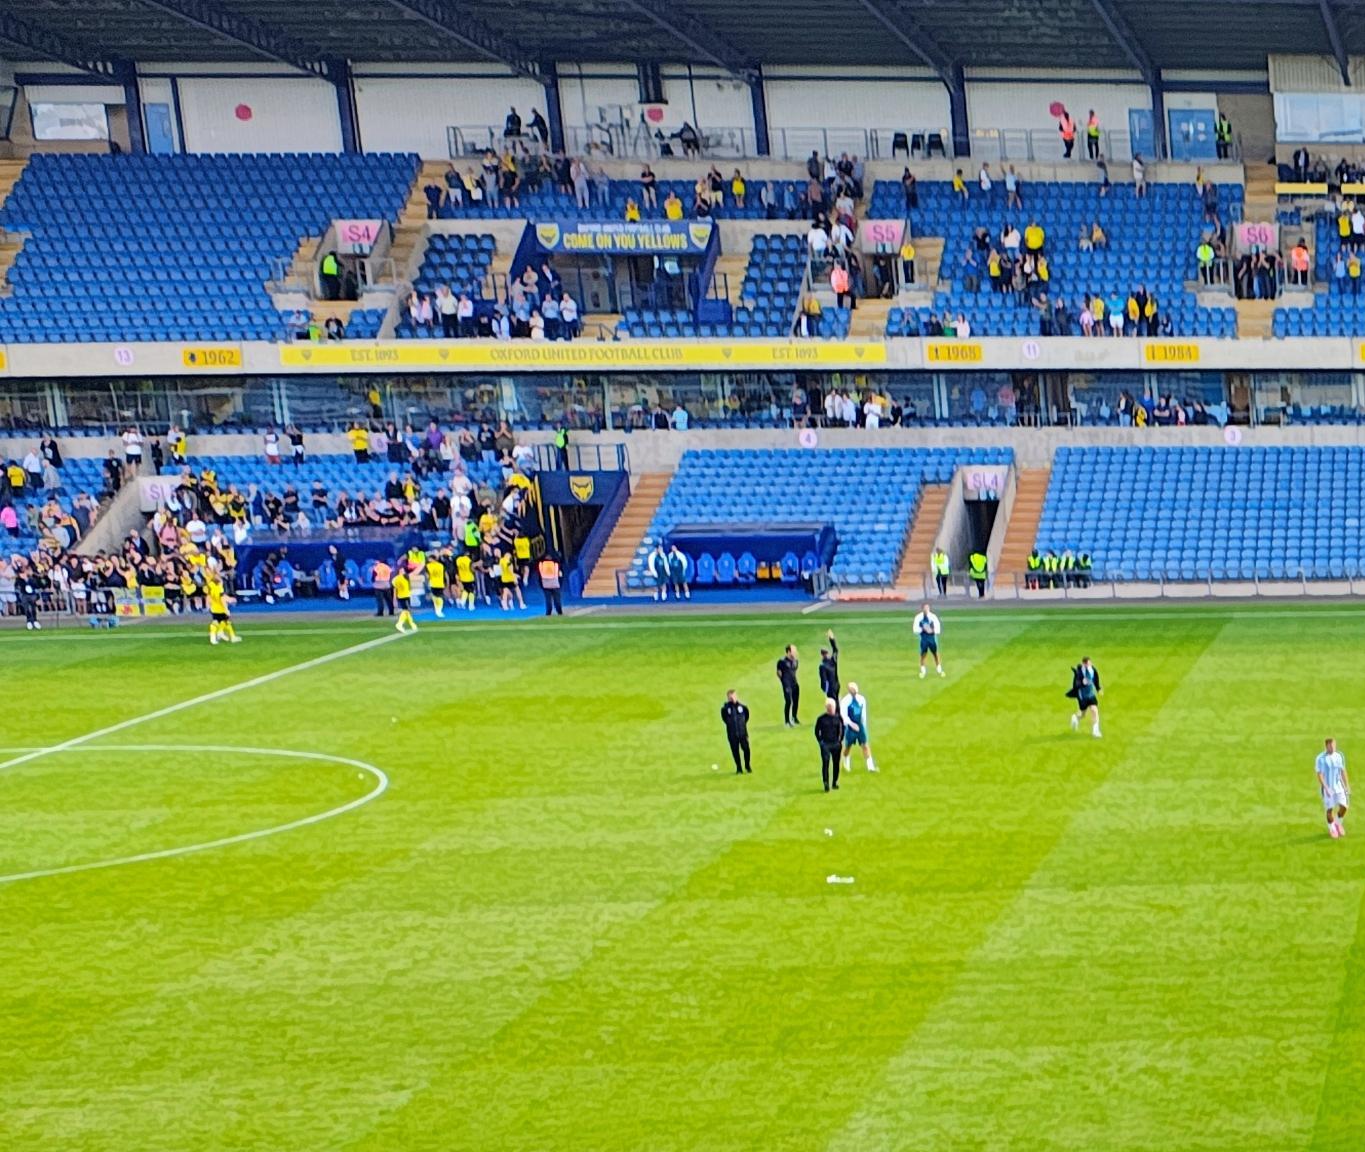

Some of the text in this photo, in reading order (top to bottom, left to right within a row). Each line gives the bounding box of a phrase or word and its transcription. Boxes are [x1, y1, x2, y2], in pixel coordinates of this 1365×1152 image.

[562, 232, 688, 249] COME ON YOU YELLOWS
[201, 350, 235, 365] 1962
[490, 348, 683, 361] OXFORD UNITED FOOTBALL CLUB
